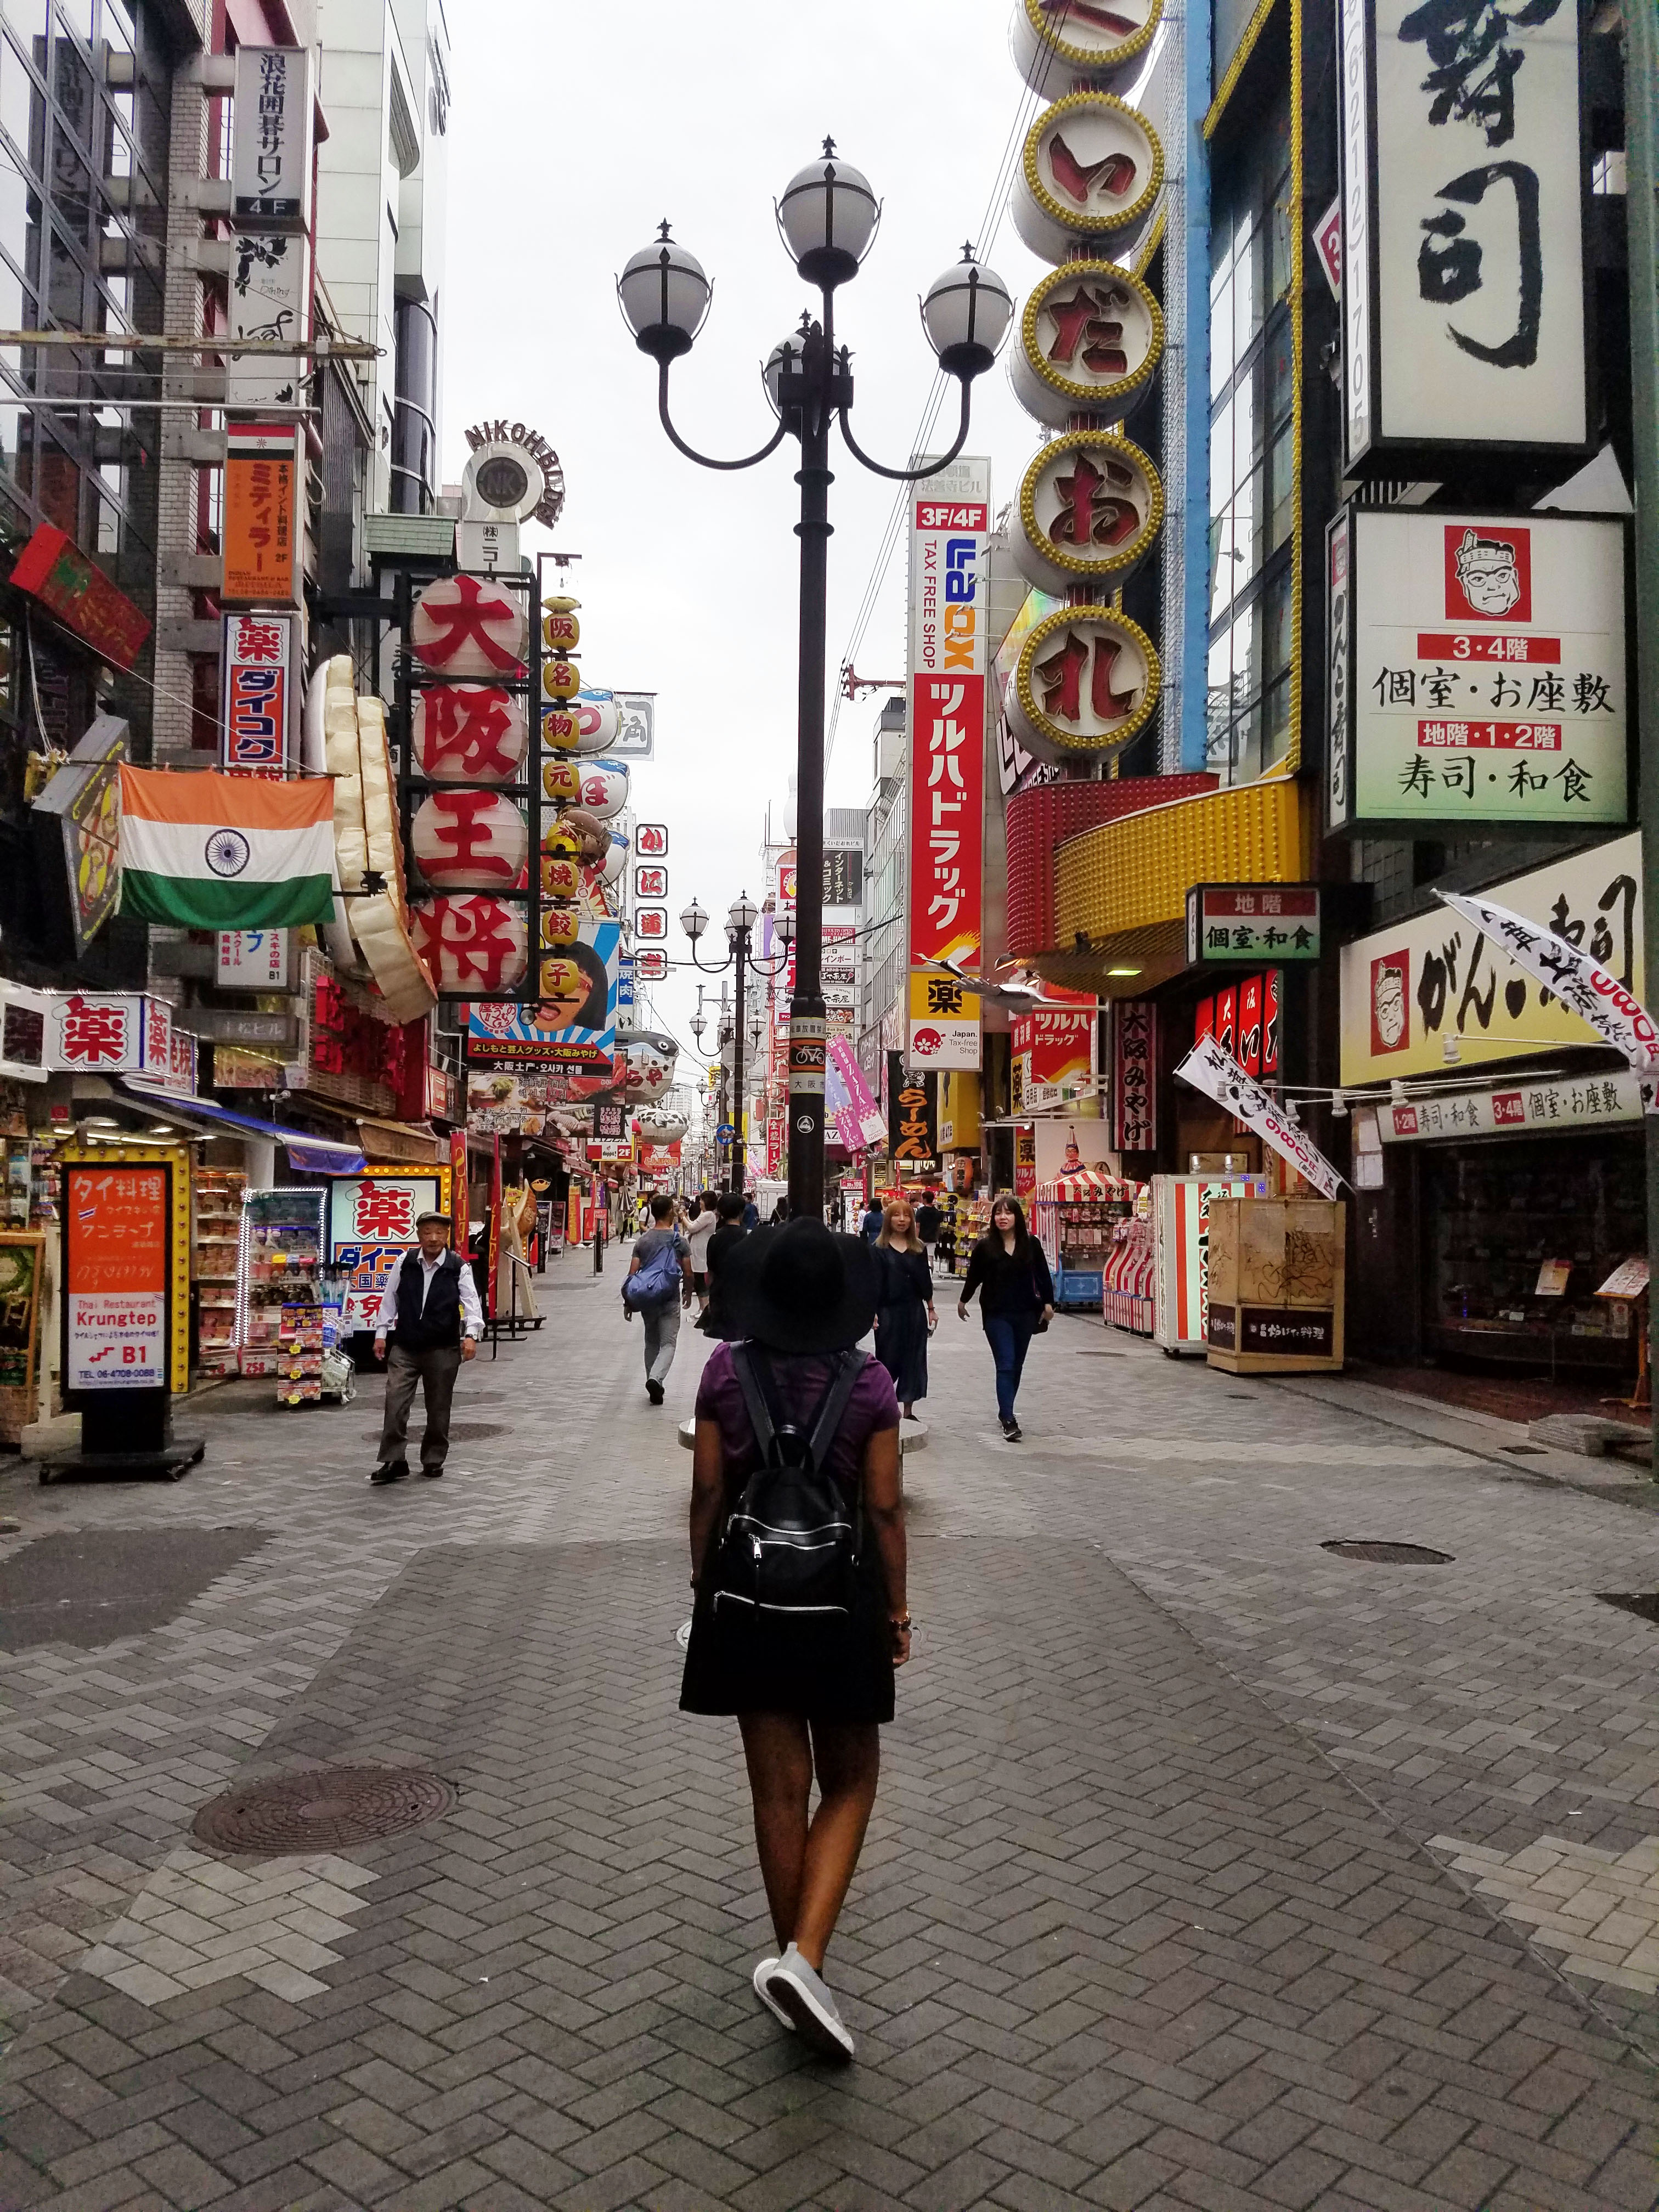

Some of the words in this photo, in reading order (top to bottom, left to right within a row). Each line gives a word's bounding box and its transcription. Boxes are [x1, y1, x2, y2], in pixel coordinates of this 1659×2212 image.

[257, 52, 286, 195] 浪花囲碁サロン
[921, 507, 982, 527] 3F/4F
[924, 539, 937, 571] TAX
[923, 575, 936, 619] FREE
[233, 617, 280, 661] 薬
[923, 623, 936, 669] SHOP
[1372, 665, 1615, 713] 個室・お座敷
[235, 669, 278, 759] ダイコク
[413, 575, 529, 992] 大阪王将
[1397, 753, 1593, 802] 寿司・和食
[927, 683, 968, 930] ツルハドラッグ
[834, 851, 844, 904] インターネット
[1234, 893, 1282, 914] 地階
[270, 927, 280, 968] スキの店
[1205, 924, 1314, 950] 個室・和食
[269, 971, 280, 980] B1
[928, 979, 962, 1014] 薬
[53, 996, 125, 1062] 薬
[149, 1001, 167, 1063] 薬
[952, 1030, 978, 1039] Japan.
[1035, 1013, 1089, 1030] ツルハ
[473, 1044, 598, 1058] よしもと芸人グッズ・大阪みやげ
[949, 1039, 978, 1047] Tax-free
[959, 1047, 978, 1057] Shop
[1035, 1034, 1079, 1046] ドラッグ
[1121, 1011, 1152, 1143] 大阪みやげ
[1419, 1099, 1480, 1132] 寿司・和食
[1530, 1081, 1623, 1120] 個室・お座敷
[894, 1088, 932, 1159] らーめん
[1073, 1185, 1129, 1198] 大阪みやげ
[346, 1181, 411, 1237] 薬
[339, 1246, 405, 1271] ダイコ
[76, 1311, 157, 1327] Krungtep
[78, 1300, 97, 1310] Thai
[104, 1300, 156, 1309] Restaurant
[122, 1346, 146, 1364] B1
[78, 1370, 94, 1379] TEL
